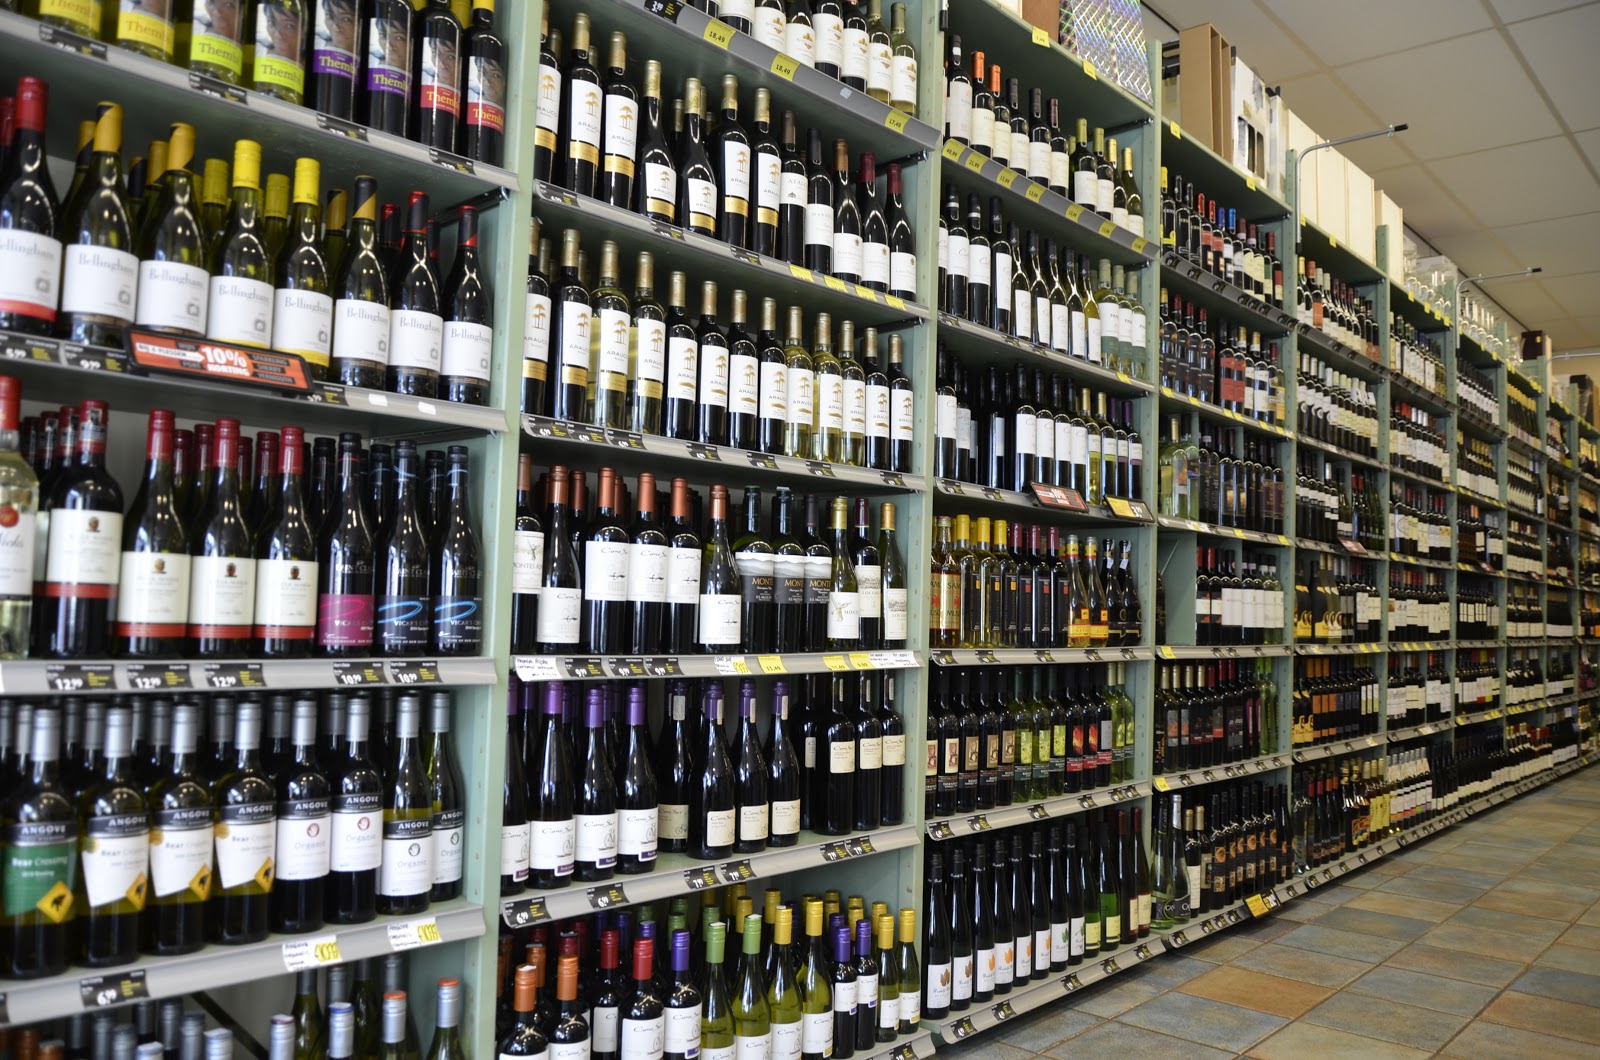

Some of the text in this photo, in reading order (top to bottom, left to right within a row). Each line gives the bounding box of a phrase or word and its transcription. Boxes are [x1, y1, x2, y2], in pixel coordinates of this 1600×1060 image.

[709, 31, 726, 43] 18,49
[0, 238, 54, 260] ellingham
[218, 284, 270, 303] Bellingham
[202, 347, 247, 368] 10%
[207, 364, 250, 377] KORTING
[346, 795, 379, 804] ANGOVE
[295, 801, 328, 810] ANGOVE
[173, 810, 210, 820] ANGOVE
[108, 816, 147, 827] ANGOVE
[398, 821, 429, 830] ANGOVE
[22, 825, 66, 834] ANGOVE
